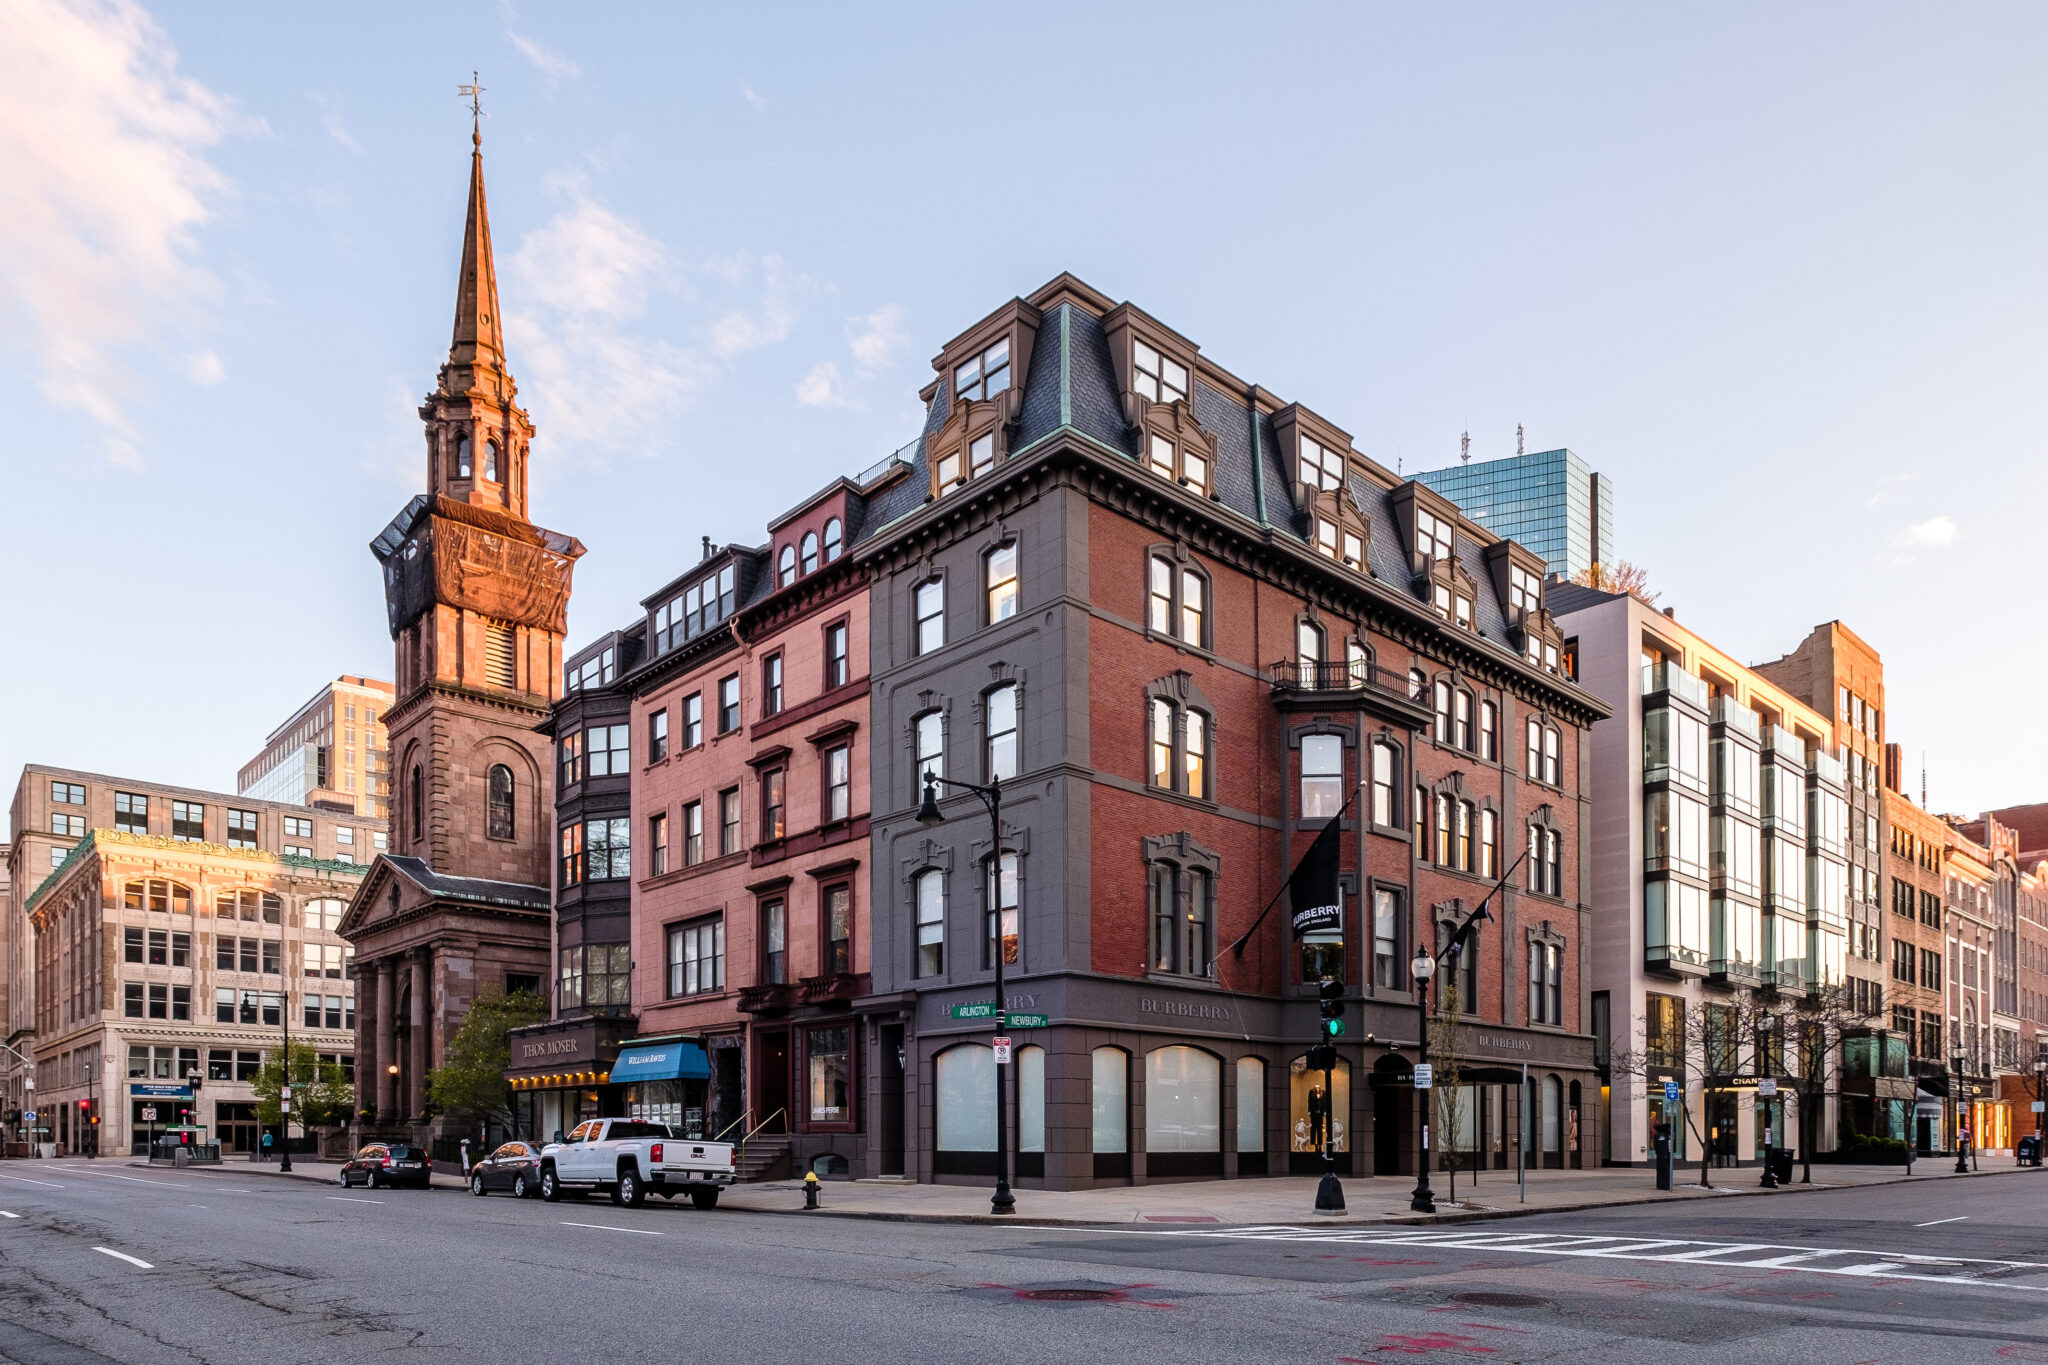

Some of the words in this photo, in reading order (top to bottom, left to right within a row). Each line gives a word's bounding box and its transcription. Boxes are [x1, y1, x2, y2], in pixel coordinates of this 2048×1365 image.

[960, 1006, 990, 1016] ARLINGTON
[1141, 999, 1233, 1020] BURBERRY
[1011, 1016, 1041, 1026] NEWBURY
[547, 1039, 578, 1055] MOSER
[1480, 1035, 1531, 1050] BURBERRY
[826, 1106, 840, 1114] PERSE
